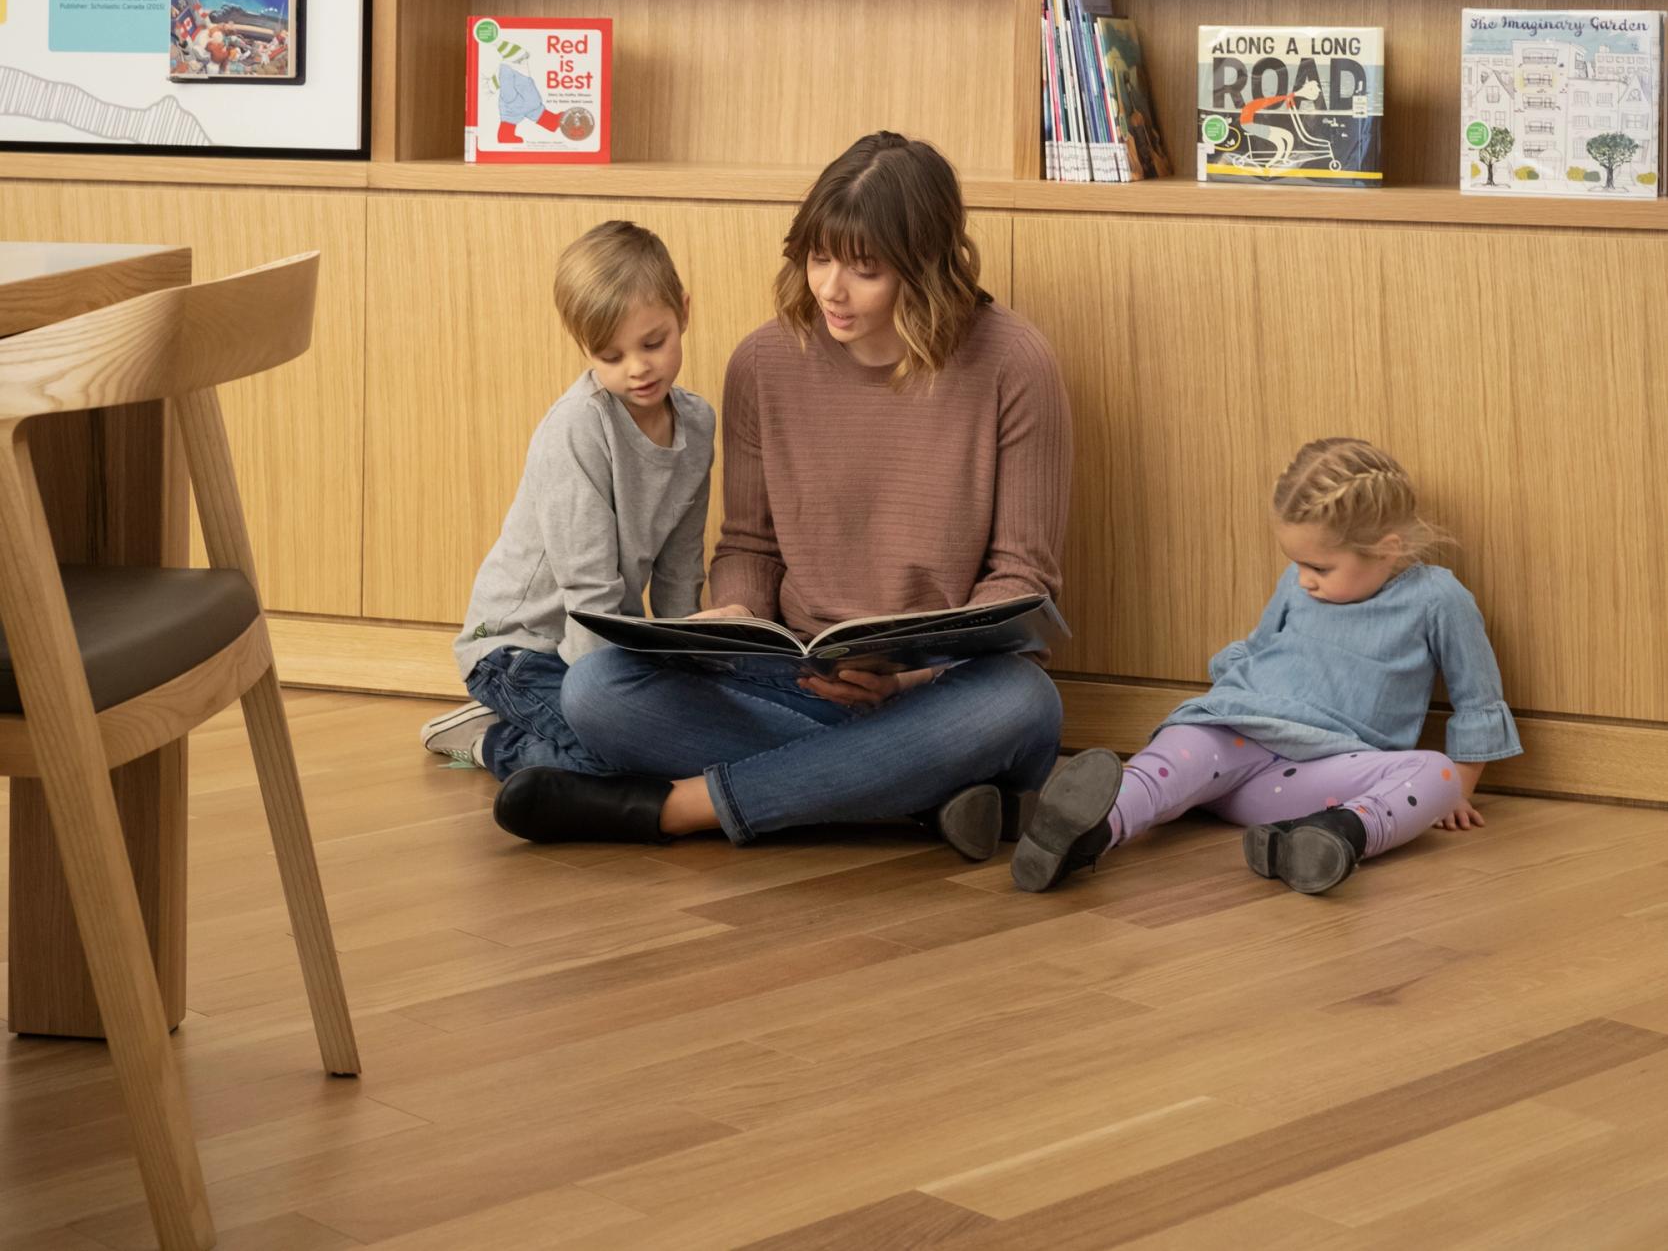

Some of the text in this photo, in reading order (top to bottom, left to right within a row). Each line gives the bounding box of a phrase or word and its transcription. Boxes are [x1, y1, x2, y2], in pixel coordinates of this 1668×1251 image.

[1470, 16, 1649, 38] The Imaginary Garden
[547, 34, 588, 54] Red
[1212, 36, 1361, 56] ALONG A LONG
[559, 55, 574, 72] is
[546, 70, 593, 89] Best
[1212, 57, 1367, 111] ROAD
